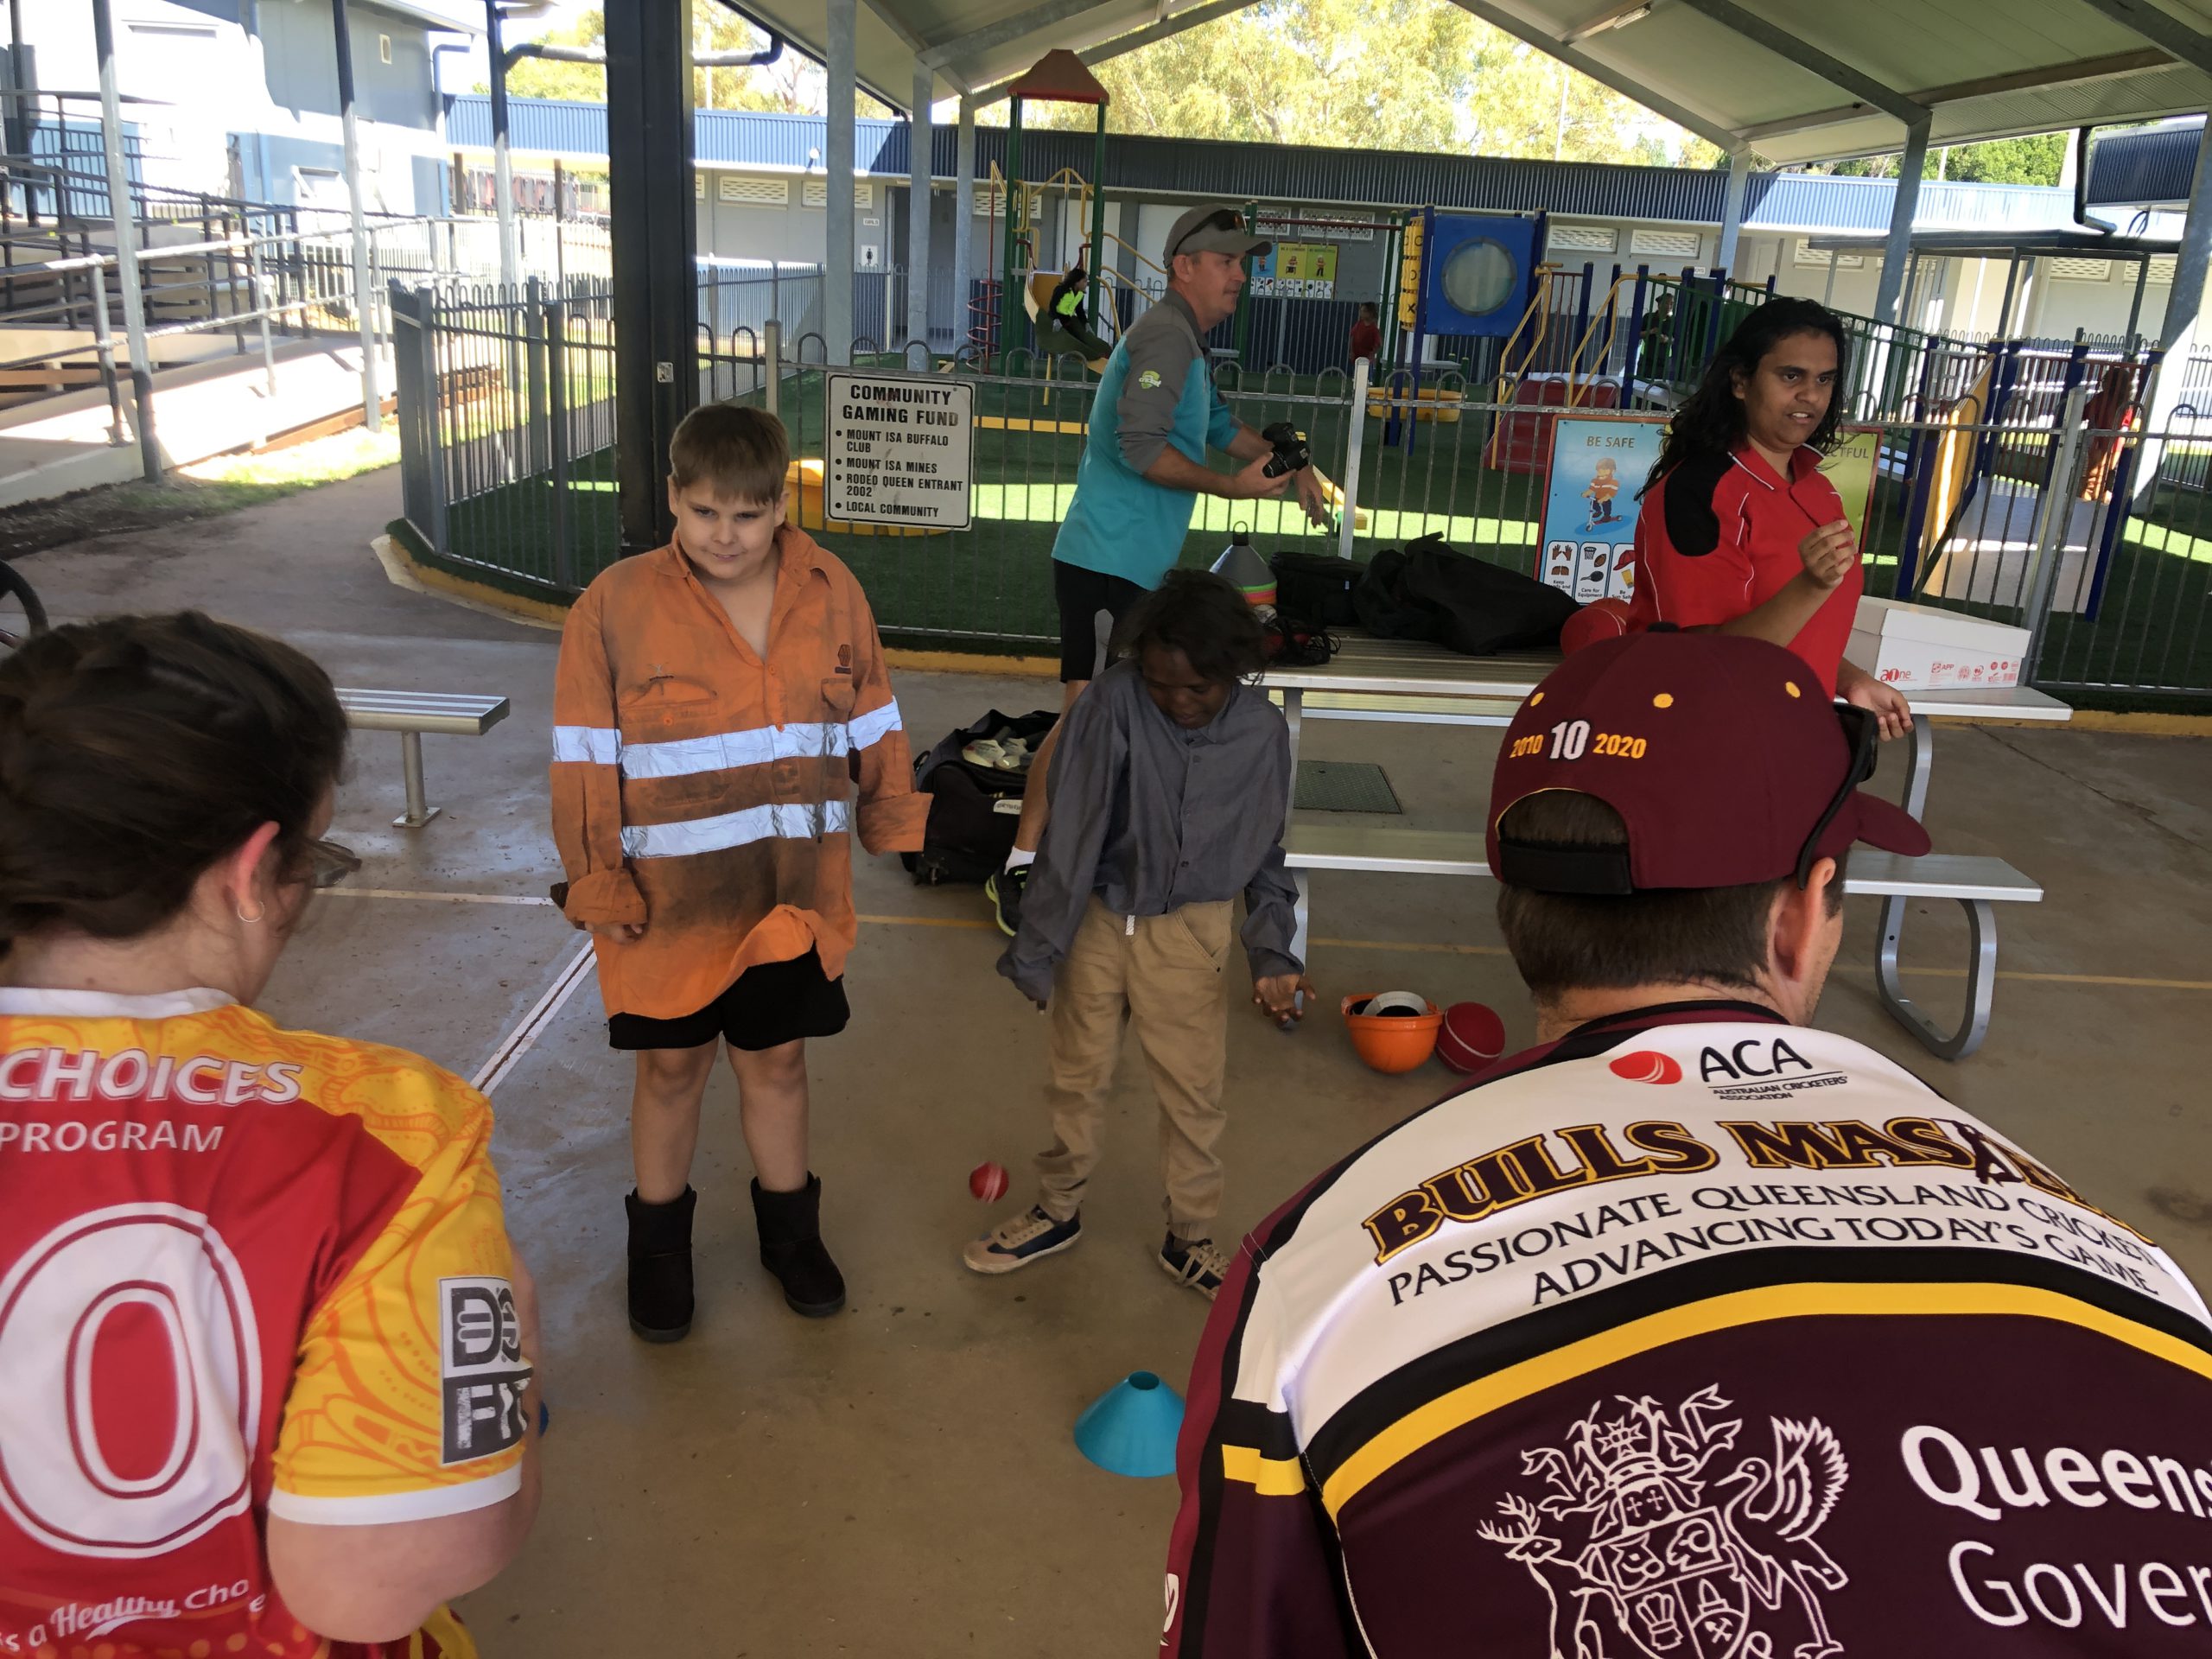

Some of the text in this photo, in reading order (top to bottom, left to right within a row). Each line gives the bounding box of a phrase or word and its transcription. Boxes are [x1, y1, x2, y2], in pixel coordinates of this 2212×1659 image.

[850, 385, 951, 405] COMMUNITY
[842, 404, 959, 427] GAMING FUND
[847, 429, 949, 446] MOUNT ISA BUFFALO
[847, 442, 871, 453] CLUB
[1586, 435, 1636, 448] BE SAFE
[847, 457, 938, 474] MOUNT ISA MINES
[847, 474, 963, 492] RODEO QUEEN ENTRANT
[847, 486, 872, 497] 2002
[847, 501, 938, 518] LOCAL COMMUNITY
[1509, 720, 1648, 760] 2010 10 2020
[1700, 1038, 1814, 1083] ACA
[0, 1046, 304, 1106] CHOICES
[1713, 1084, 1781, 1095] AUSTRALIAN
[1719, 1091, 1794, 1101] ASSOCIATION
[0, 1120, 224, 1153] PROGRAM
[1361, 1121, 1721, 1267] BULLS
[1387, 1192, 1681, 1306] PASSIONATE
[1691, 1184, 2011, 1211] QUEENSLAND
[1532, 1217, 2160, 1306] ADVANCING TODAY'S GAME
[1948, 1540, 2212, 1629] Gover
[29, 1624, 47, 1647] a
[50, 1597, 181, 1642] Healthy
